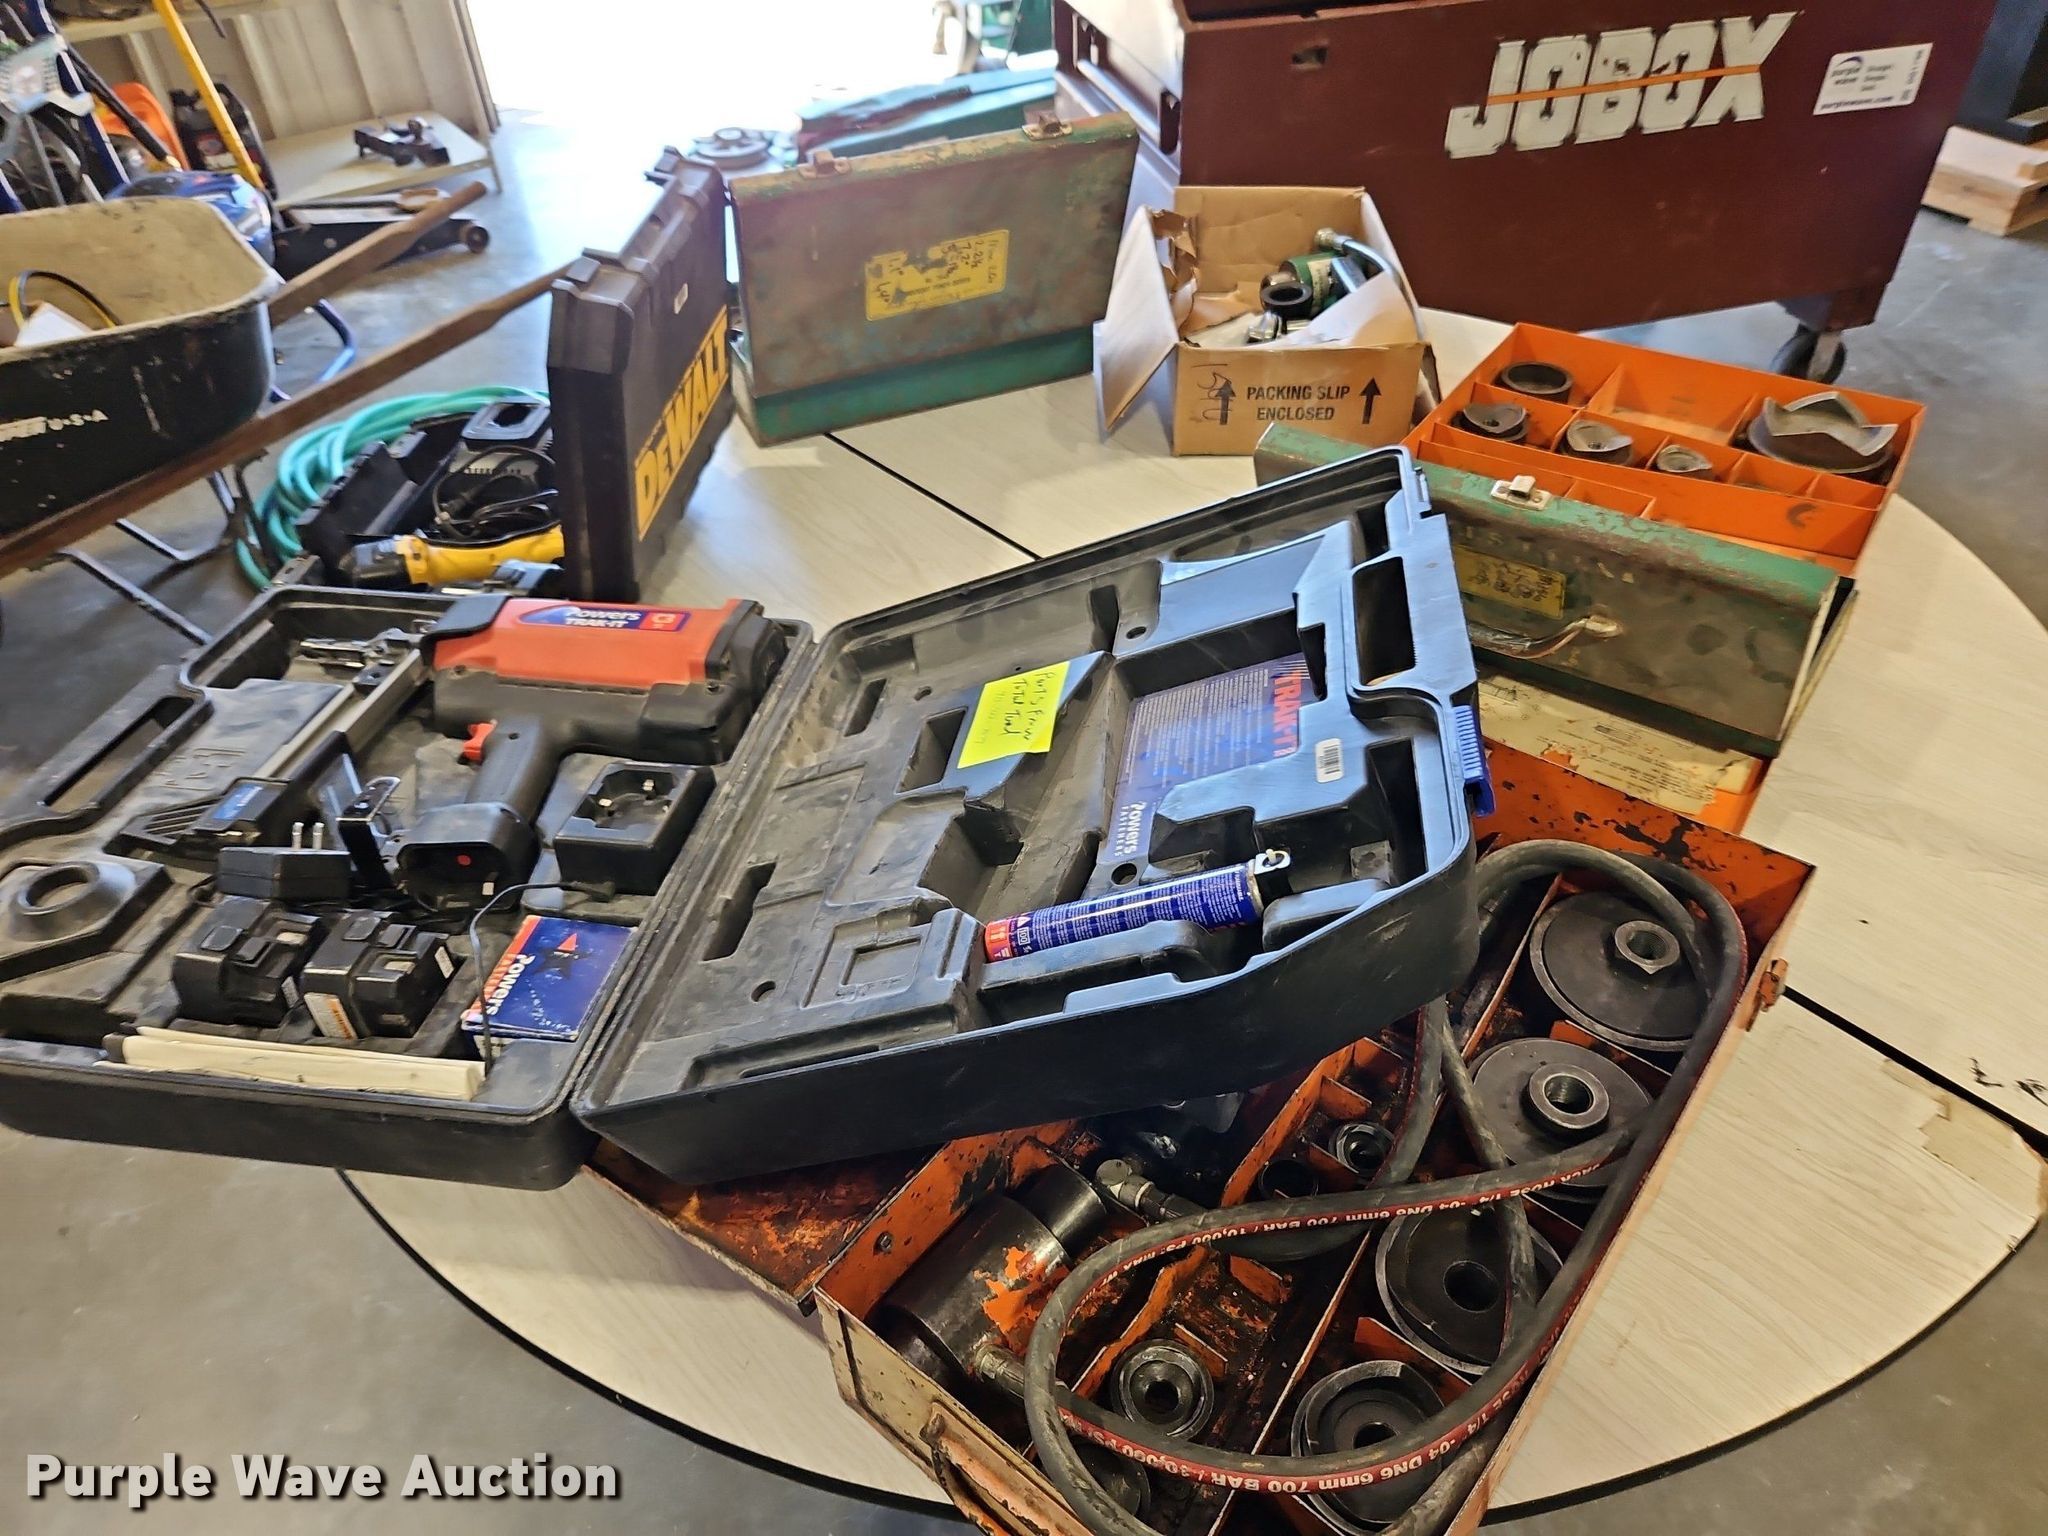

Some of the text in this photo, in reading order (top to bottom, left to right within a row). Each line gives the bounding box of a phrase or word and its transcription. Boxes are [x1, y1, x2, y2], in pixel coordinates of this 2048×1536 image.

[1445, 11, 1797, 158] JOBOX
[1247, 385, 1350, 401] PACKING SLIP
[1256, 407, 1335, 421] ENCLOSED
[1123, 801, 1148, 856] Powers
[485, 954, 536, 1016] Powers
[1429, 1438, 1456, 1462] -04
[1380, 1455, 1424, 1479] DN6
[1211, 1472, 1260, 1491] BAR
[1267, 1480, 1308, 1494] 700
[1319, 1472, 1374, 1491] 6mm
